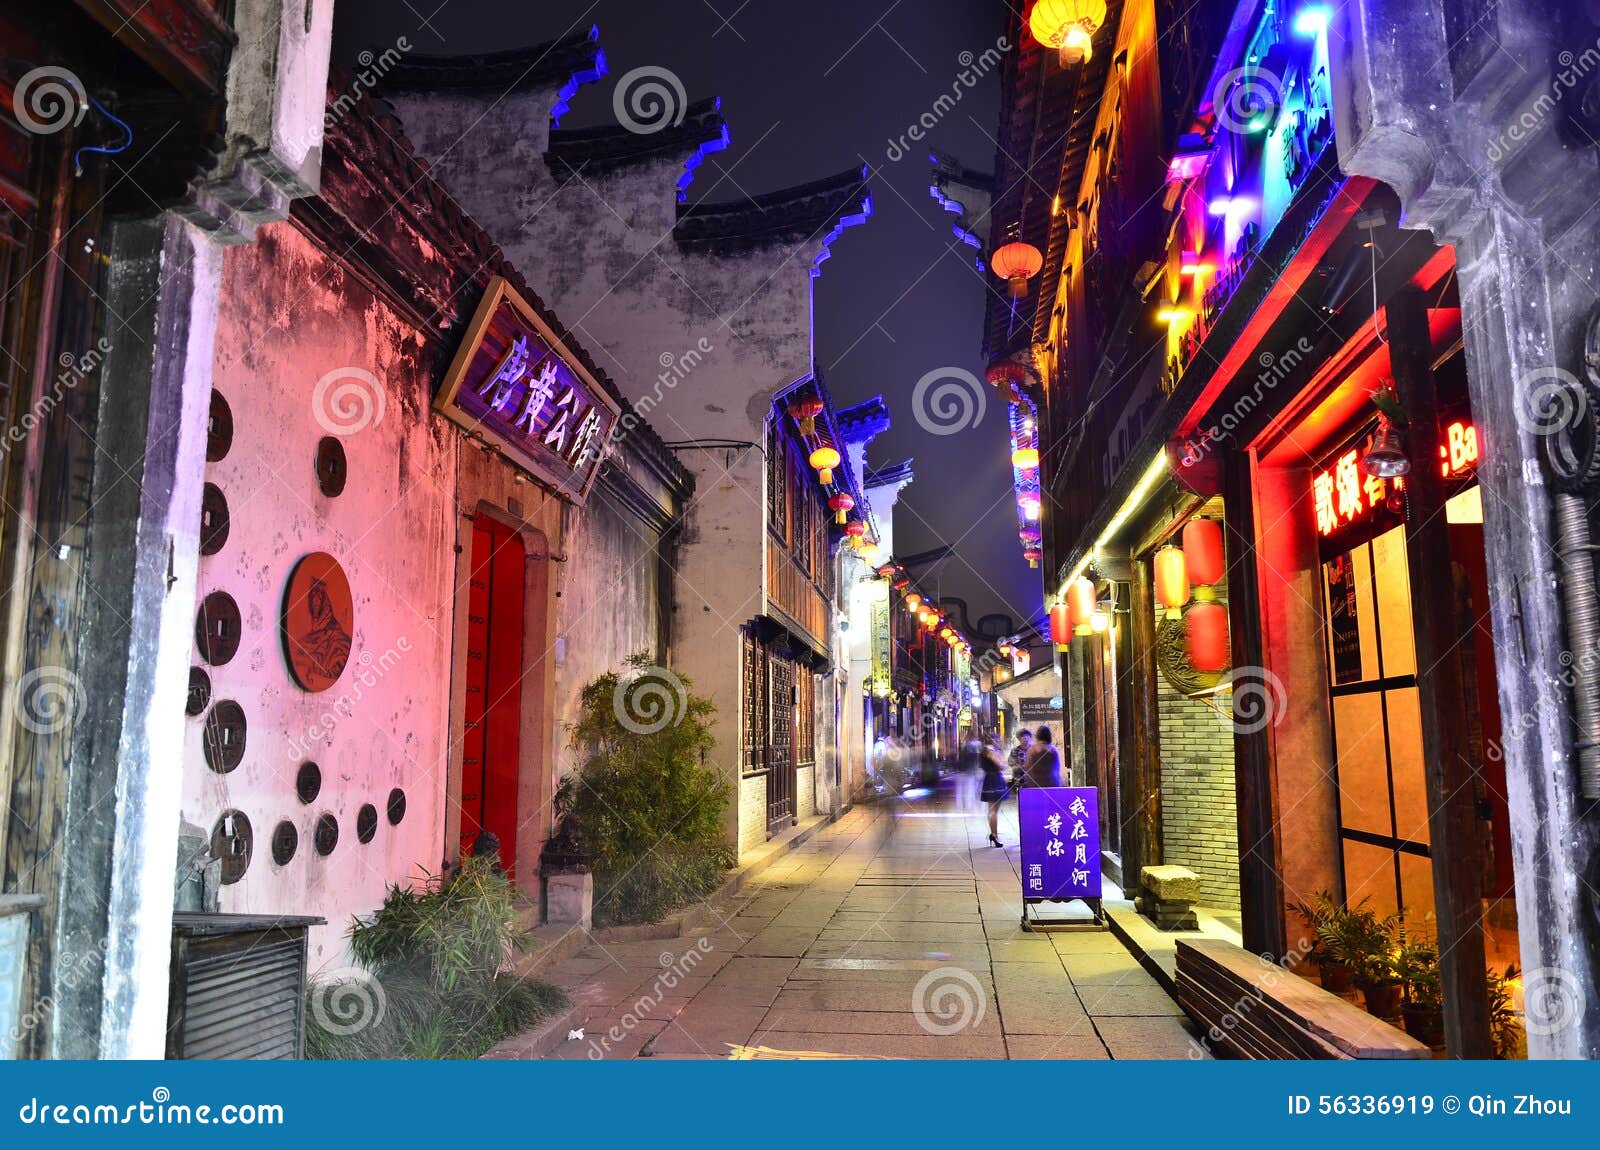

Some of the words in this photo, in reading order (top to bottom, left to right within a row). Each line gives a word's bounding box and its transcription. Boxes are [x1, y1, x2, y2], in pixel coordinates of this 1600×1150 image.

[1043, 812, 1065, 857] 等你
[1068, 795, 1091, 888] 我在月河
[1028, 863, 1043, 891] 酒吧
